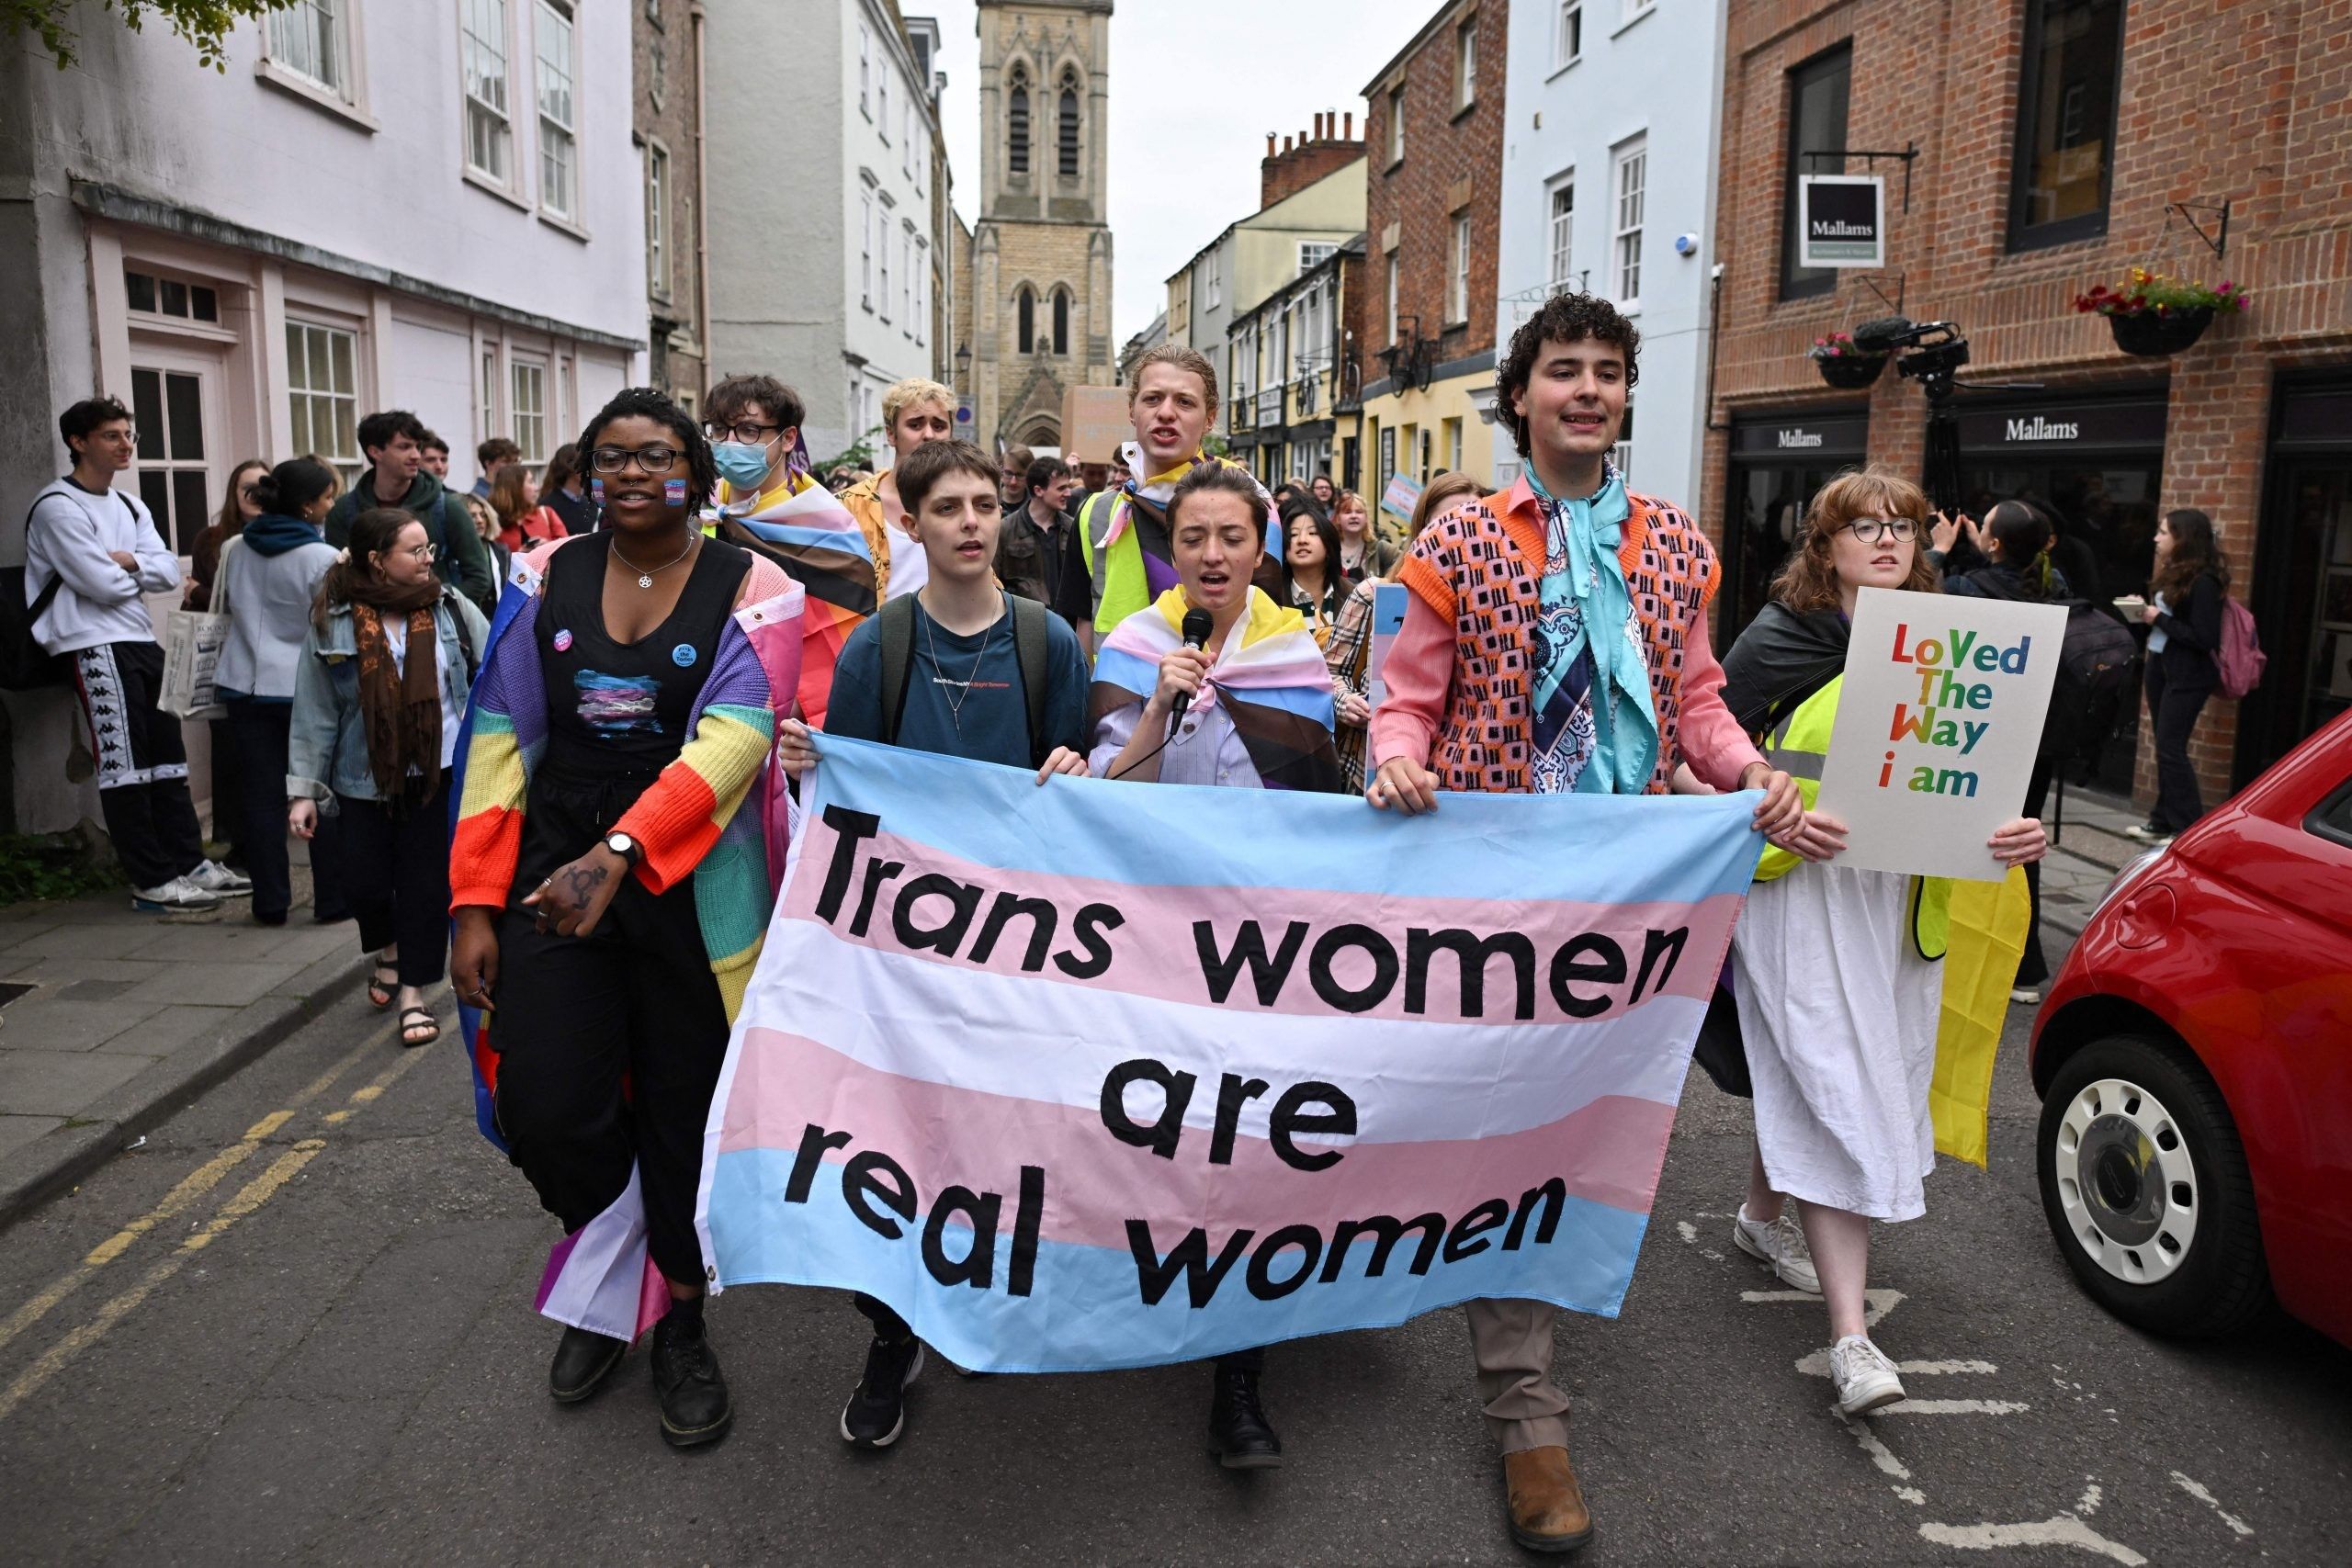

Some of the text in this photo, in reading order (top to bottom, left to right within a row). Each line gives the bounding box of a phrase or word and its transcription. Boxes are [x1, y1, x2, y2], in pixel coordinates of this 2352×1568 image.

[1813, 220, 1873, 236] Mallams
[1778, 429, 1822, 447] Mallams
[2006, 416, 2078, 441] Mallams
[1892, 624, 2031, 675] LoVed
[1916, 667, 1992, 710] The
[1890, 704, 1989, 758] Way
[1879, 750, 1979, 797] i am
[815, 804, 1689, 1020] Trans women
[1100, 1058, 1357, 1172] are
[784, 1122, 1566, 1309] real women
